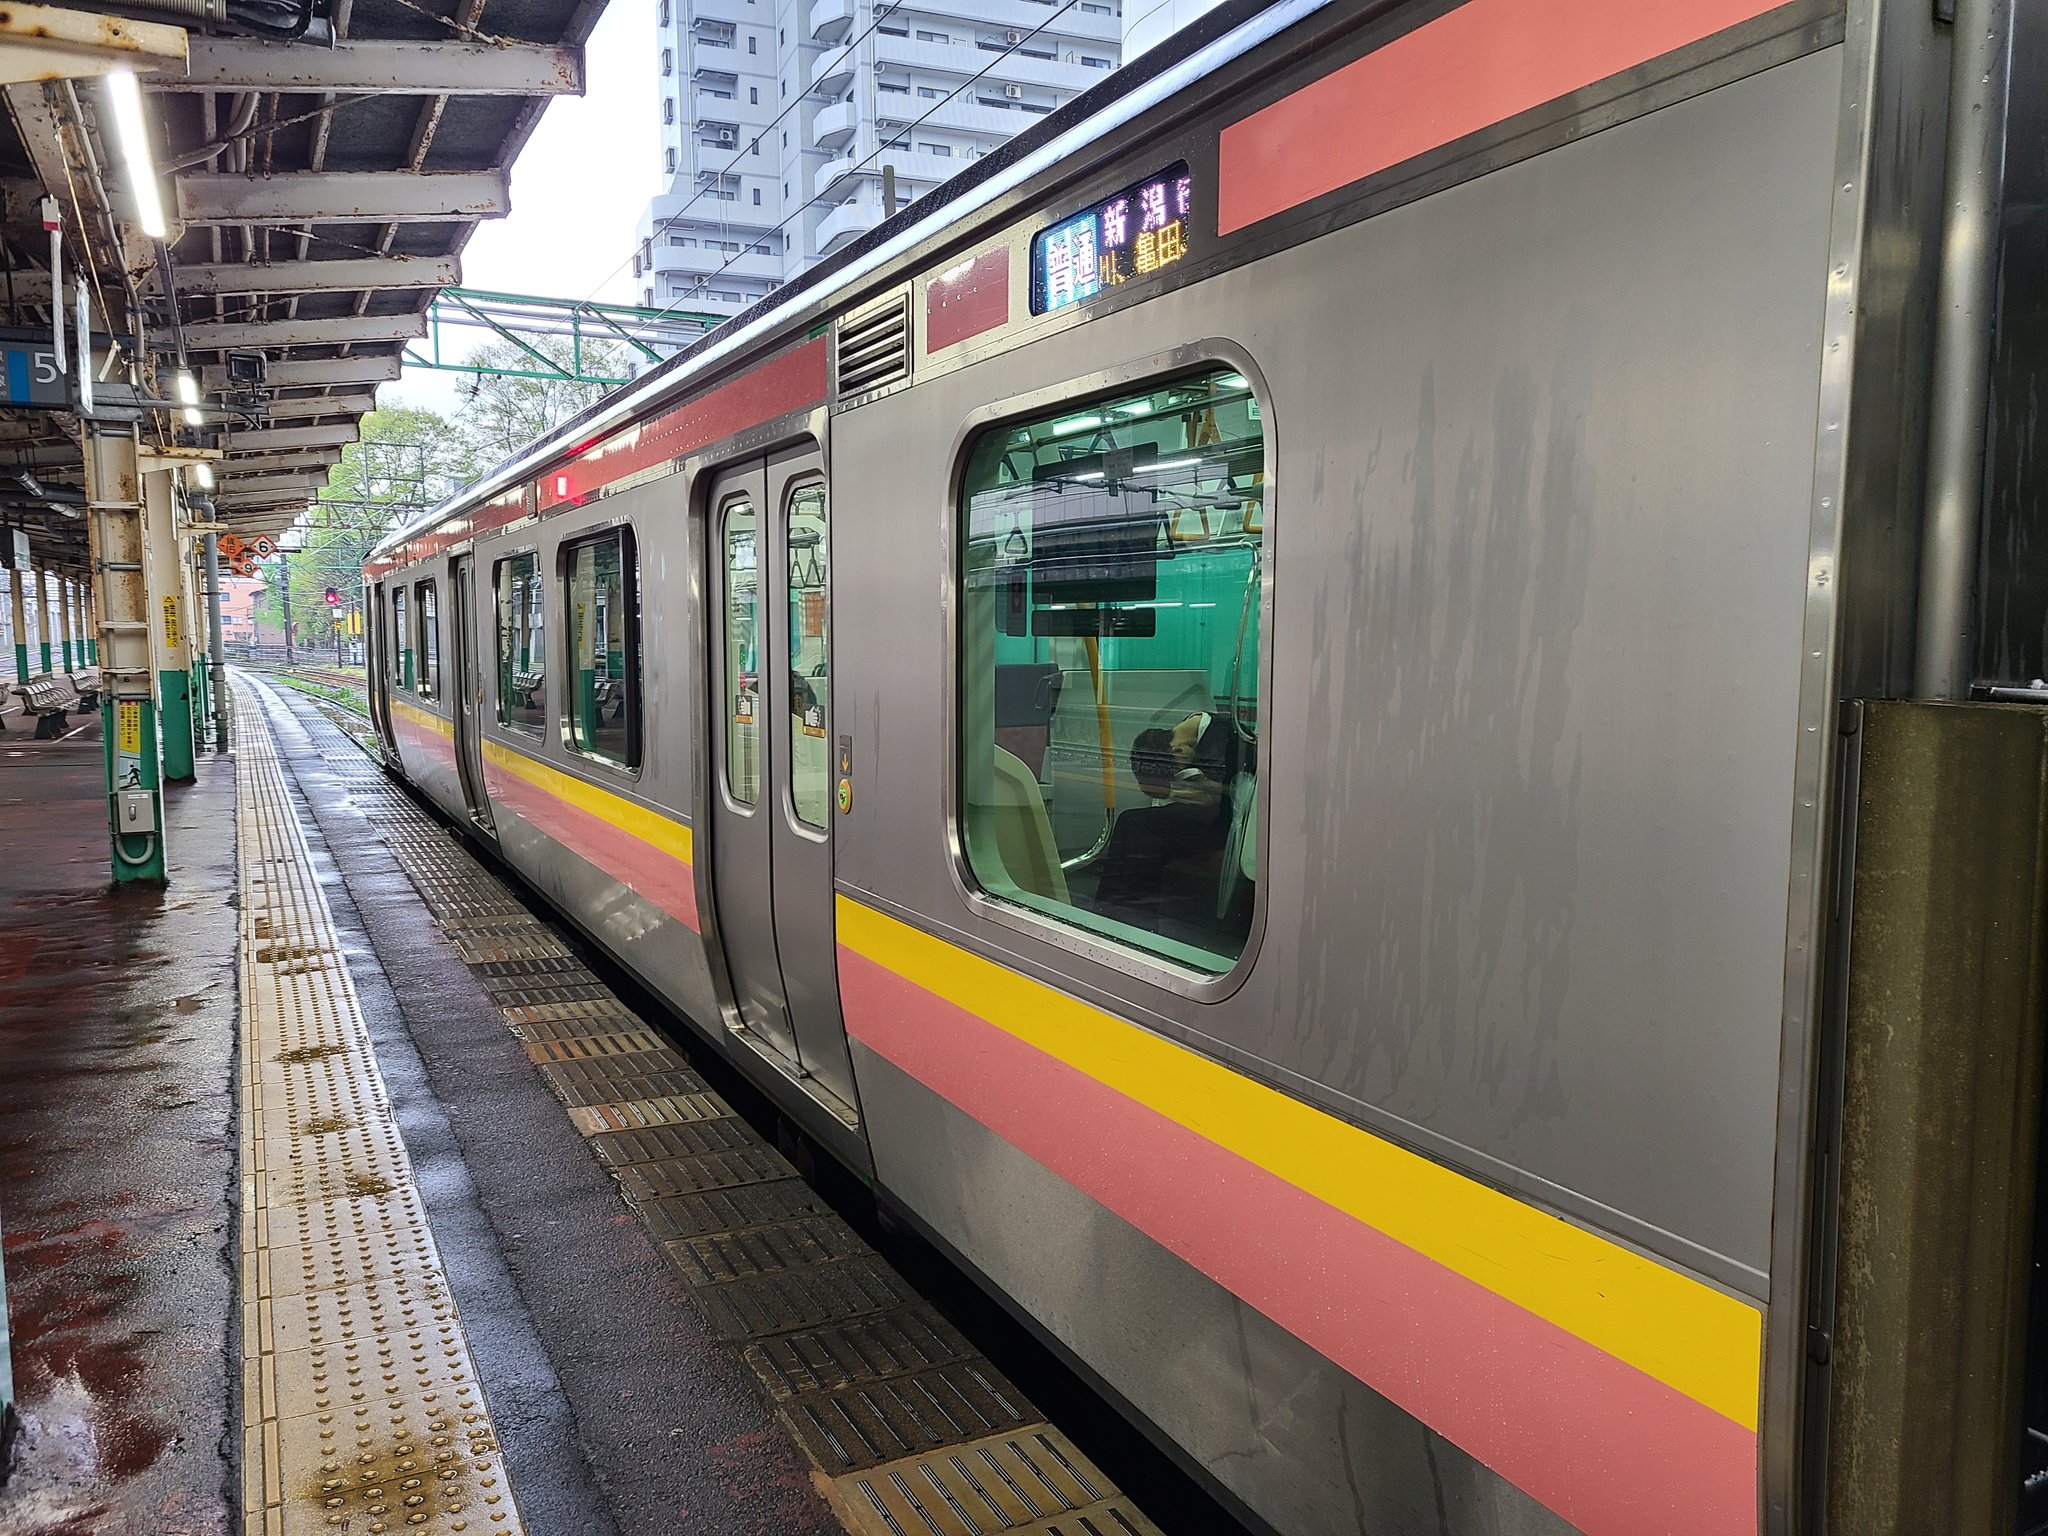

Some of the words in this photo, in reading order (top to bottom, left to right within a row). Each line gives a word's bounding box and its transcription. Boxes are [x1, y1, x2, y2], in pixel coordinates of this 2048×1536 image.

[1046, 225, 1098, 304] 普通
[34, 352, 57, 384] 5
[258, 541, 268, 553] 6
[244, 563, 253, 573] 9
